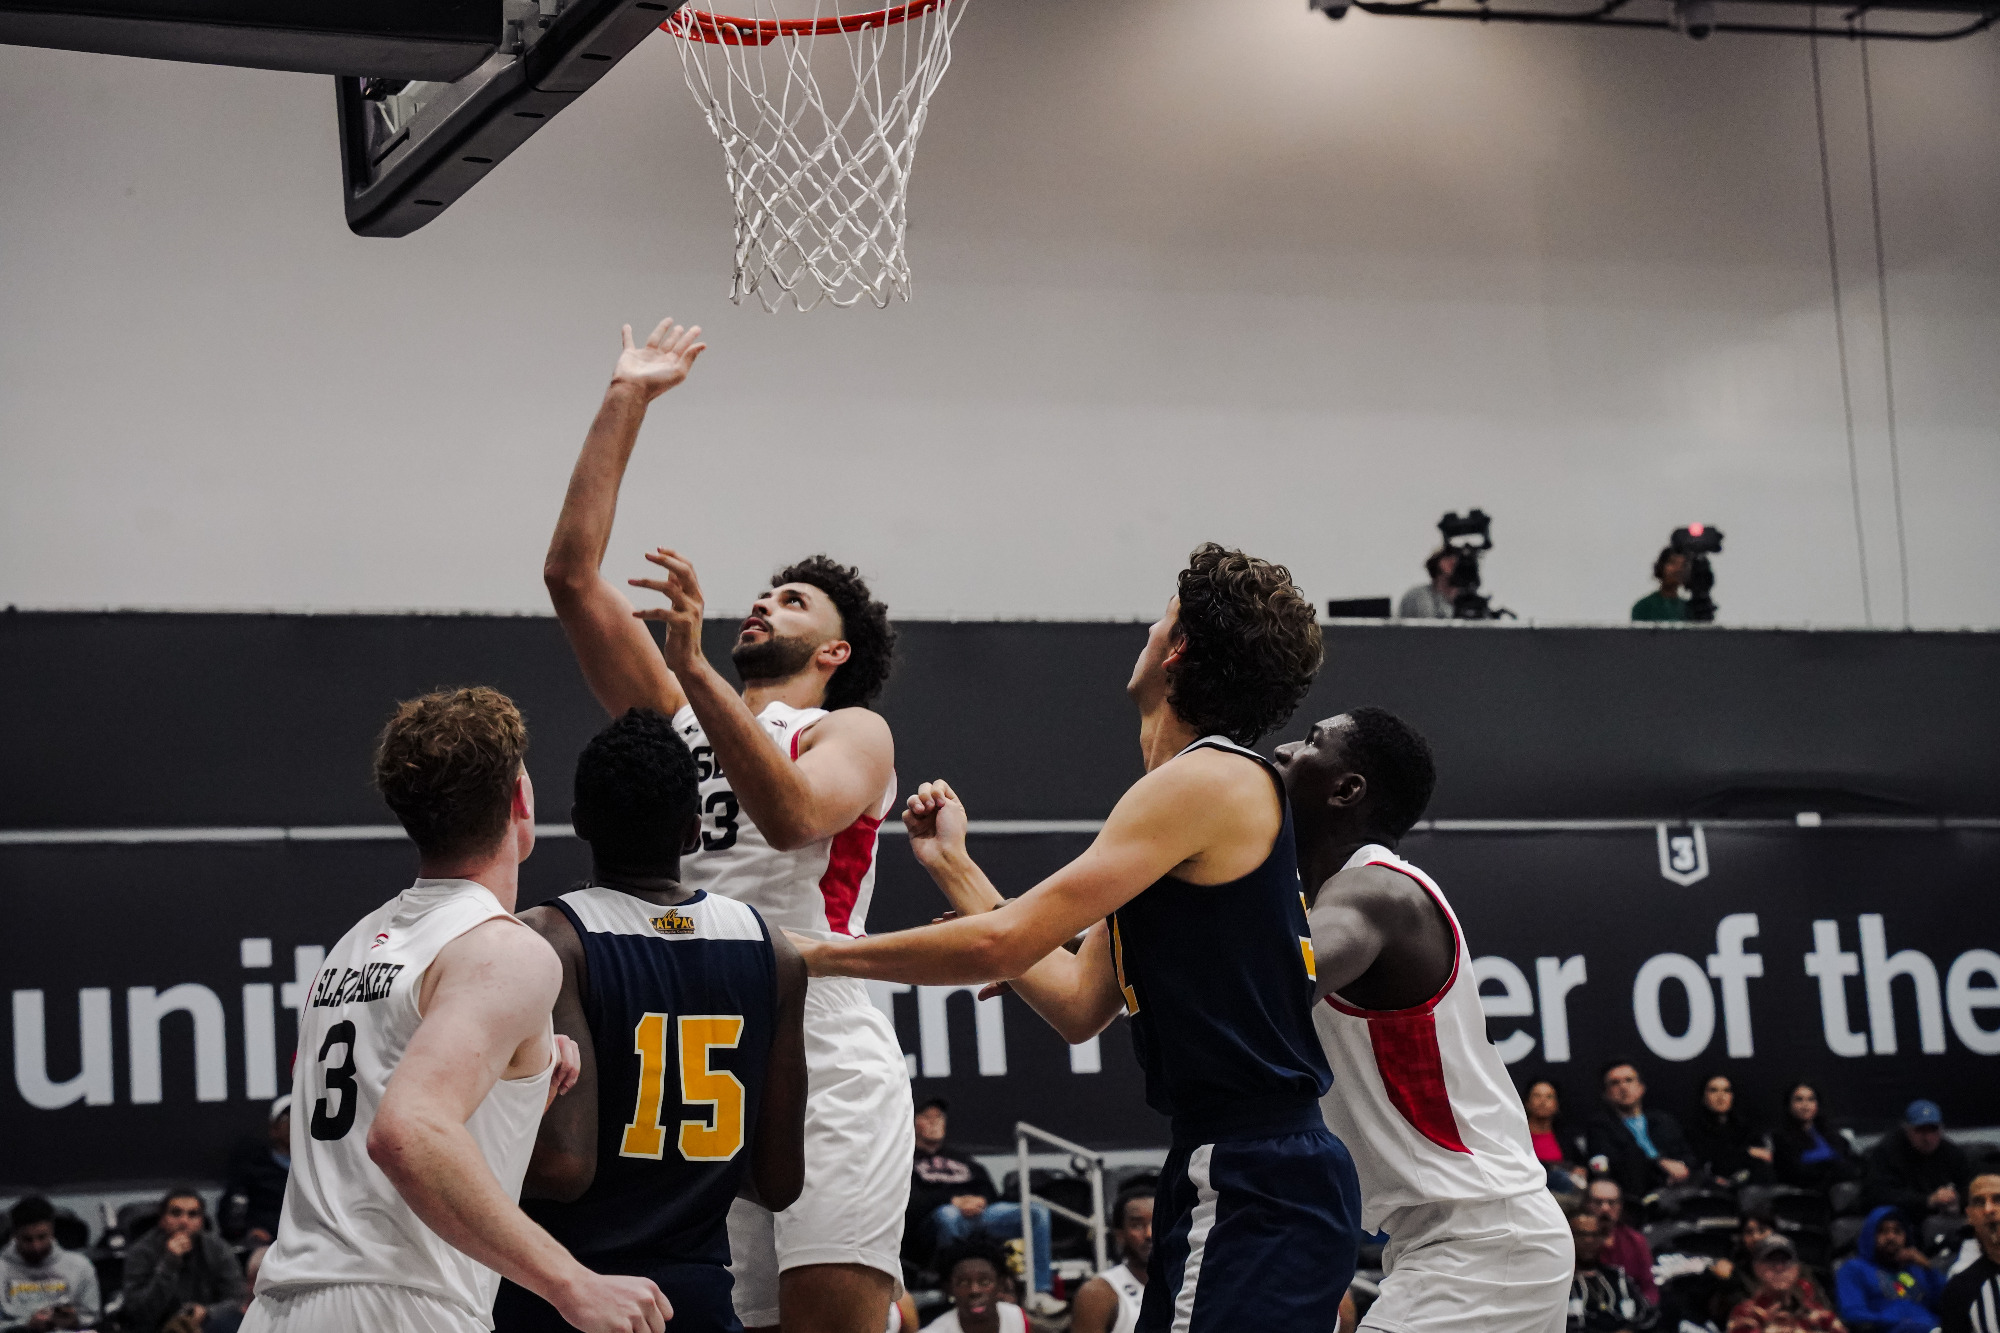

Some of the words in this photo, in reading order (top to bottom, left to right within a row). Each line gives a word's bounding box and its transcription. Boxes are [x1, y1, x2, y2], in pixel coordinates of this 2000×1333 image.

[687, 791, 739, 854] 3
[1671, 836, 1695, 870] 3
[1632, 912, 1764, 1062] of
[1804, 913, 2000, 1059] the
[310, 1019, 358, 1141] 3
[619, 1012, 745, 1161] 15
